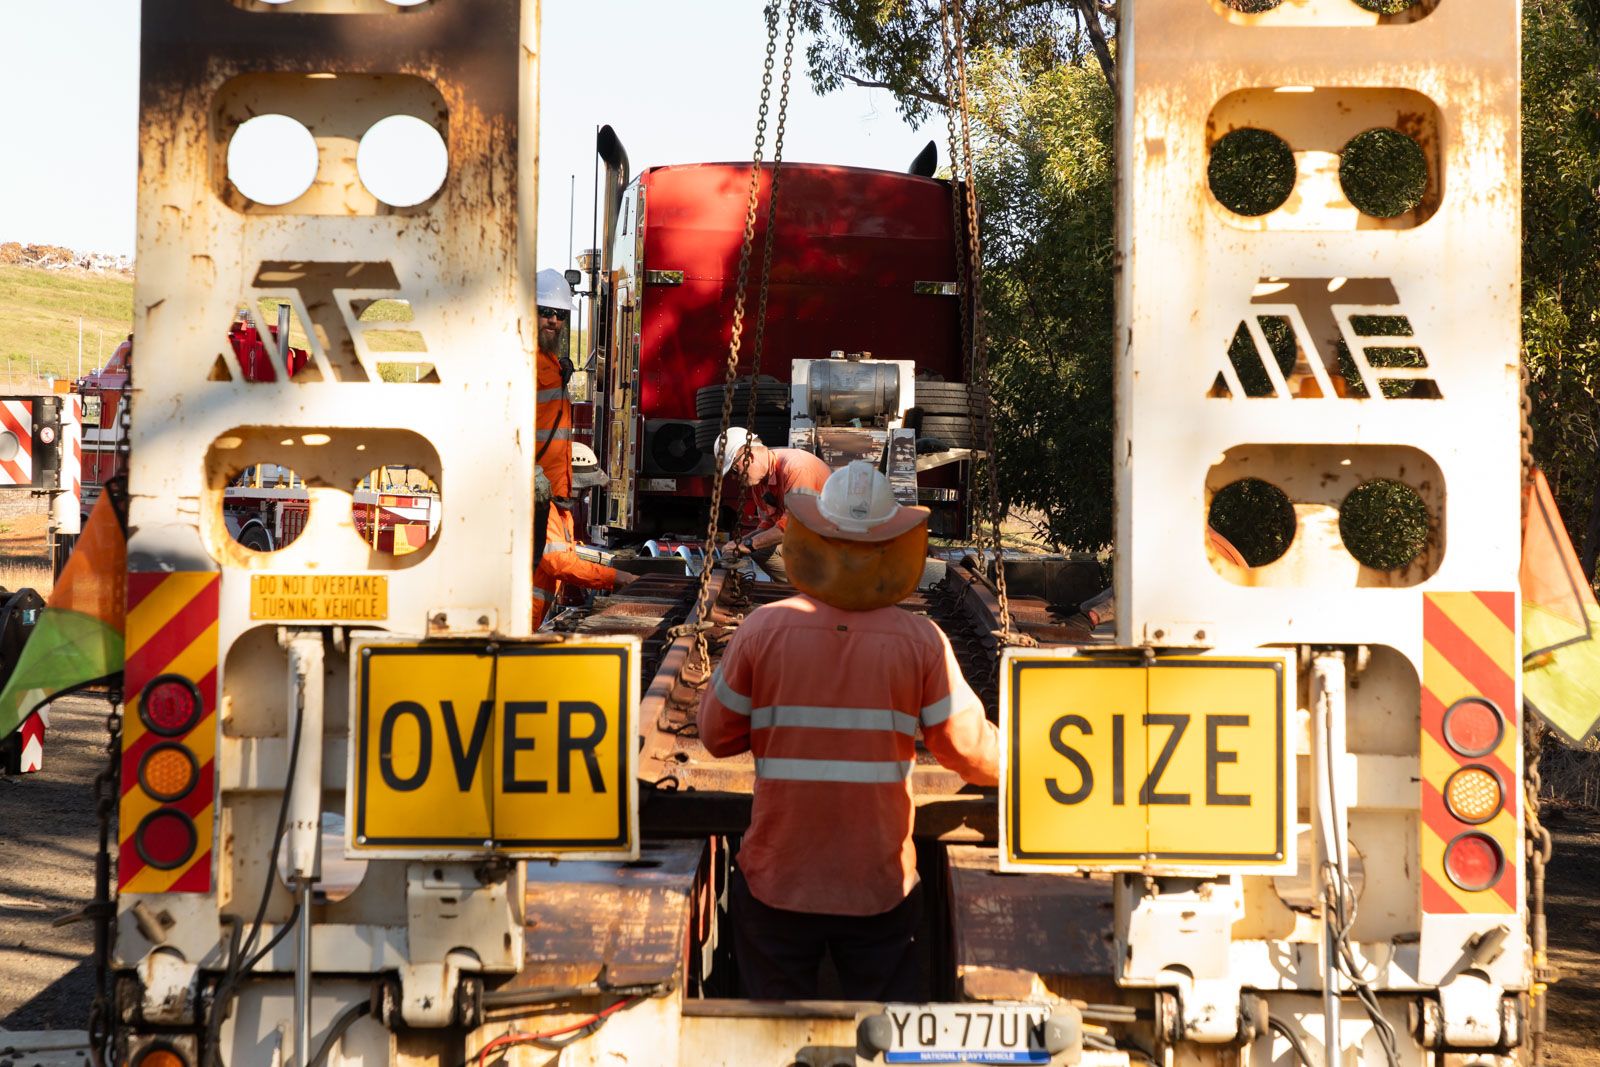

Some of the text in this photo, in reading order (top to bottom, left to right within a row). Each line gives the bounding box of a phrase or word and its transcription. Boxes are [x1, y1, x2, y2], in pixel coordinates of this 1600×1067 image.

[259, 576, 379, 596] DO NOT OVERTAKE
[262, 598, 379, 618] TURNING VEHICLE
[379, 700, 608, 794] OVER
[1044, 713, 1252, 806] SIZE
[920, 1052, 956, 1061] NATIONAL
[985, 1052, 1015, 1061] VEHICLE
